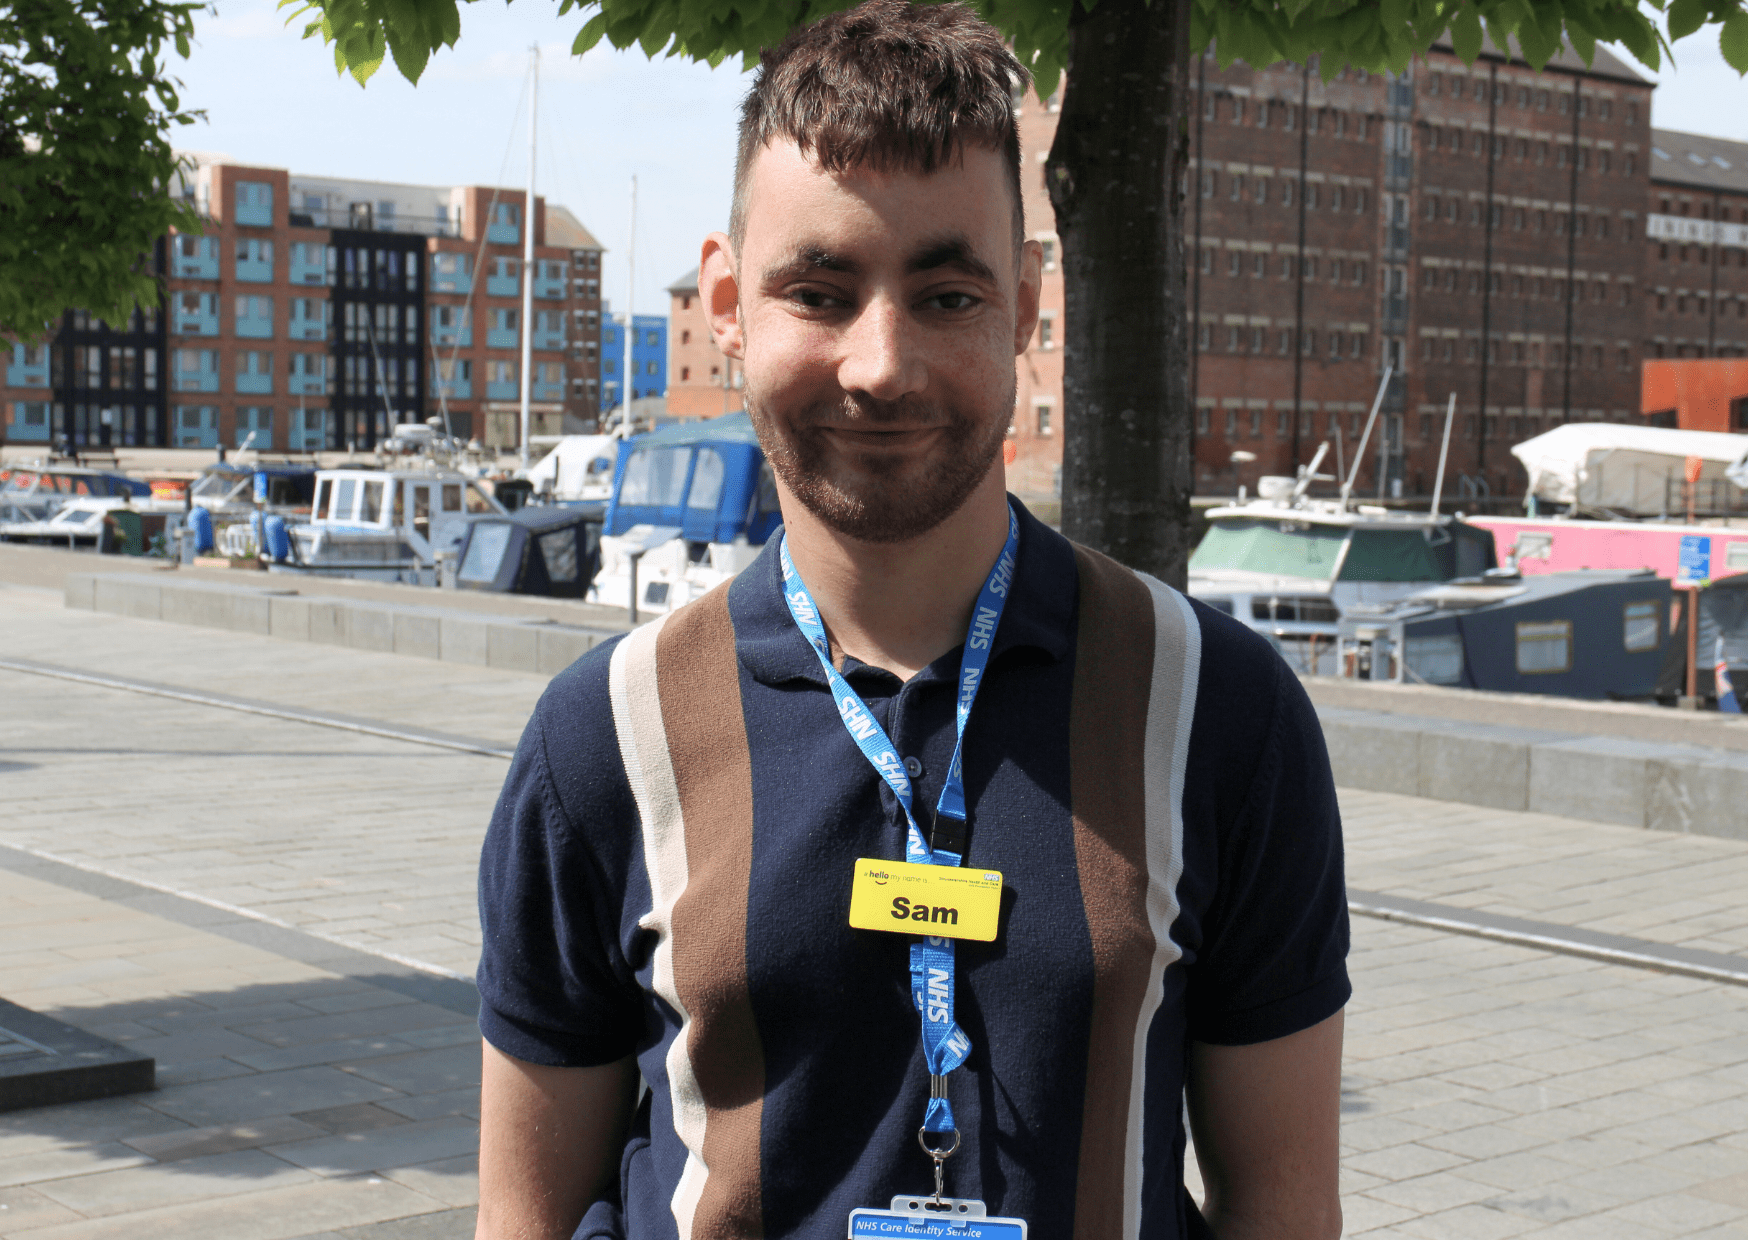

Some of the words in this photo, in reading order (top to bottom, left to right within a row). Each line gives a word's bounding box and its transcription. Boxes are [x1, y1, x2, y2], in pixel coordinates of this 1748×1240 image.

[989, 551, 1015, 598] NHS
[786, 591, 818, 626] NHS
[970, 606, 998, 650] NHS
[838, 696, 878, 741] NHS
[873, 751, 911, 797] NHS
[891, 897, 958, 925] Sam
[928, 968, 949, 1024] NHS
[856, 1221, 877, 1231] NHS
[880, 1222, 902, 1233] Care
[904, 1224, 944, 1238] Identity
[946, 1227, 982, 1238] Service
